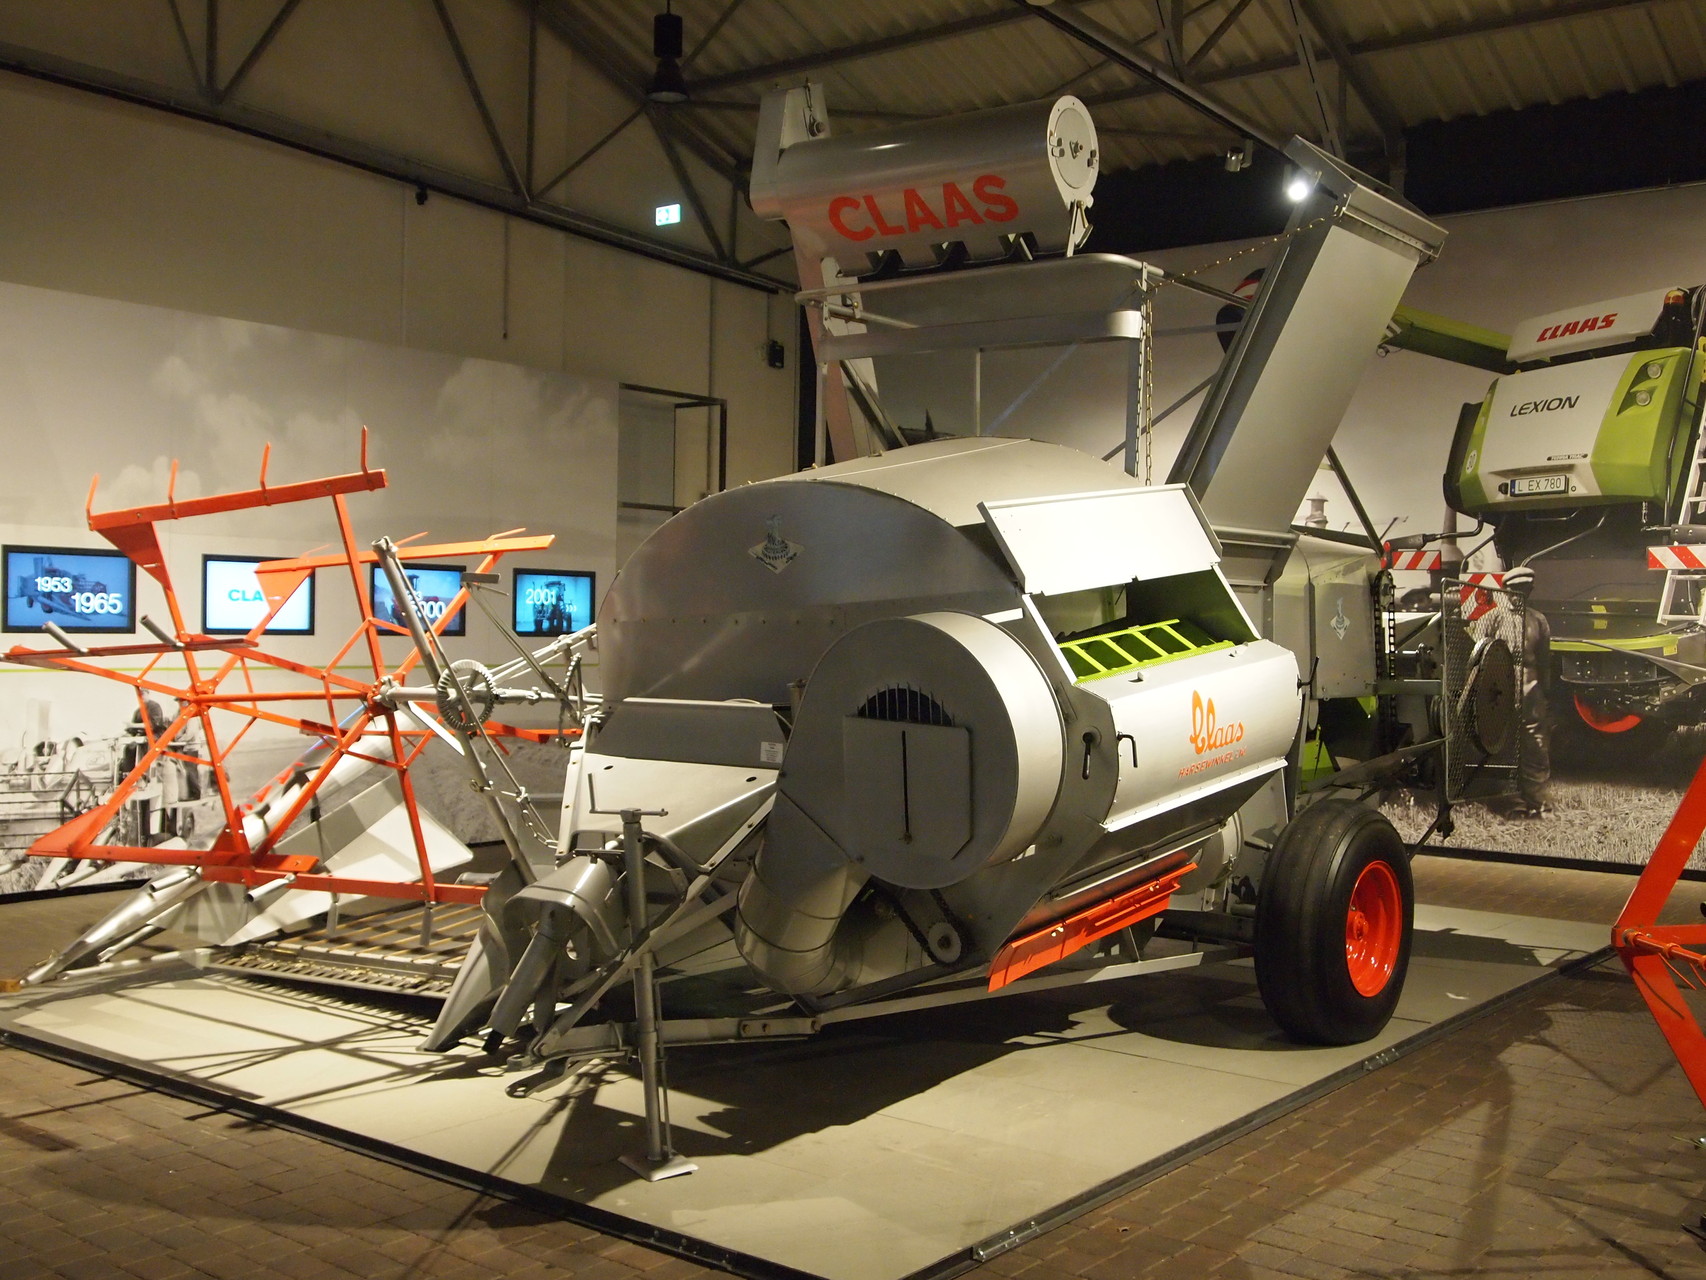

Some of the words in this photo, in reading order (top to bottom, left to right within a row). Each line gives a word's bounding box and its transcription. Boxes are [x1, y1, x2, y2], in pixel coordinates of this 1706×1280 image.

[828, 174, 1019, 242] CLAAS
[1536, 313, 1619, 343] CLAAS
[1510, 395, 1580, 417] LEXION
[1528, 480, 1542, 491] EX
[1544, 478, 1562, 490] 780
[35, 576, 73, 593] 1953
[228, 589, 264, 602] CLA
[71, 592, 123, 614] 1965
[525, 588, 557, 605] 2001
[1189, 689, 1245, 755] Claas
